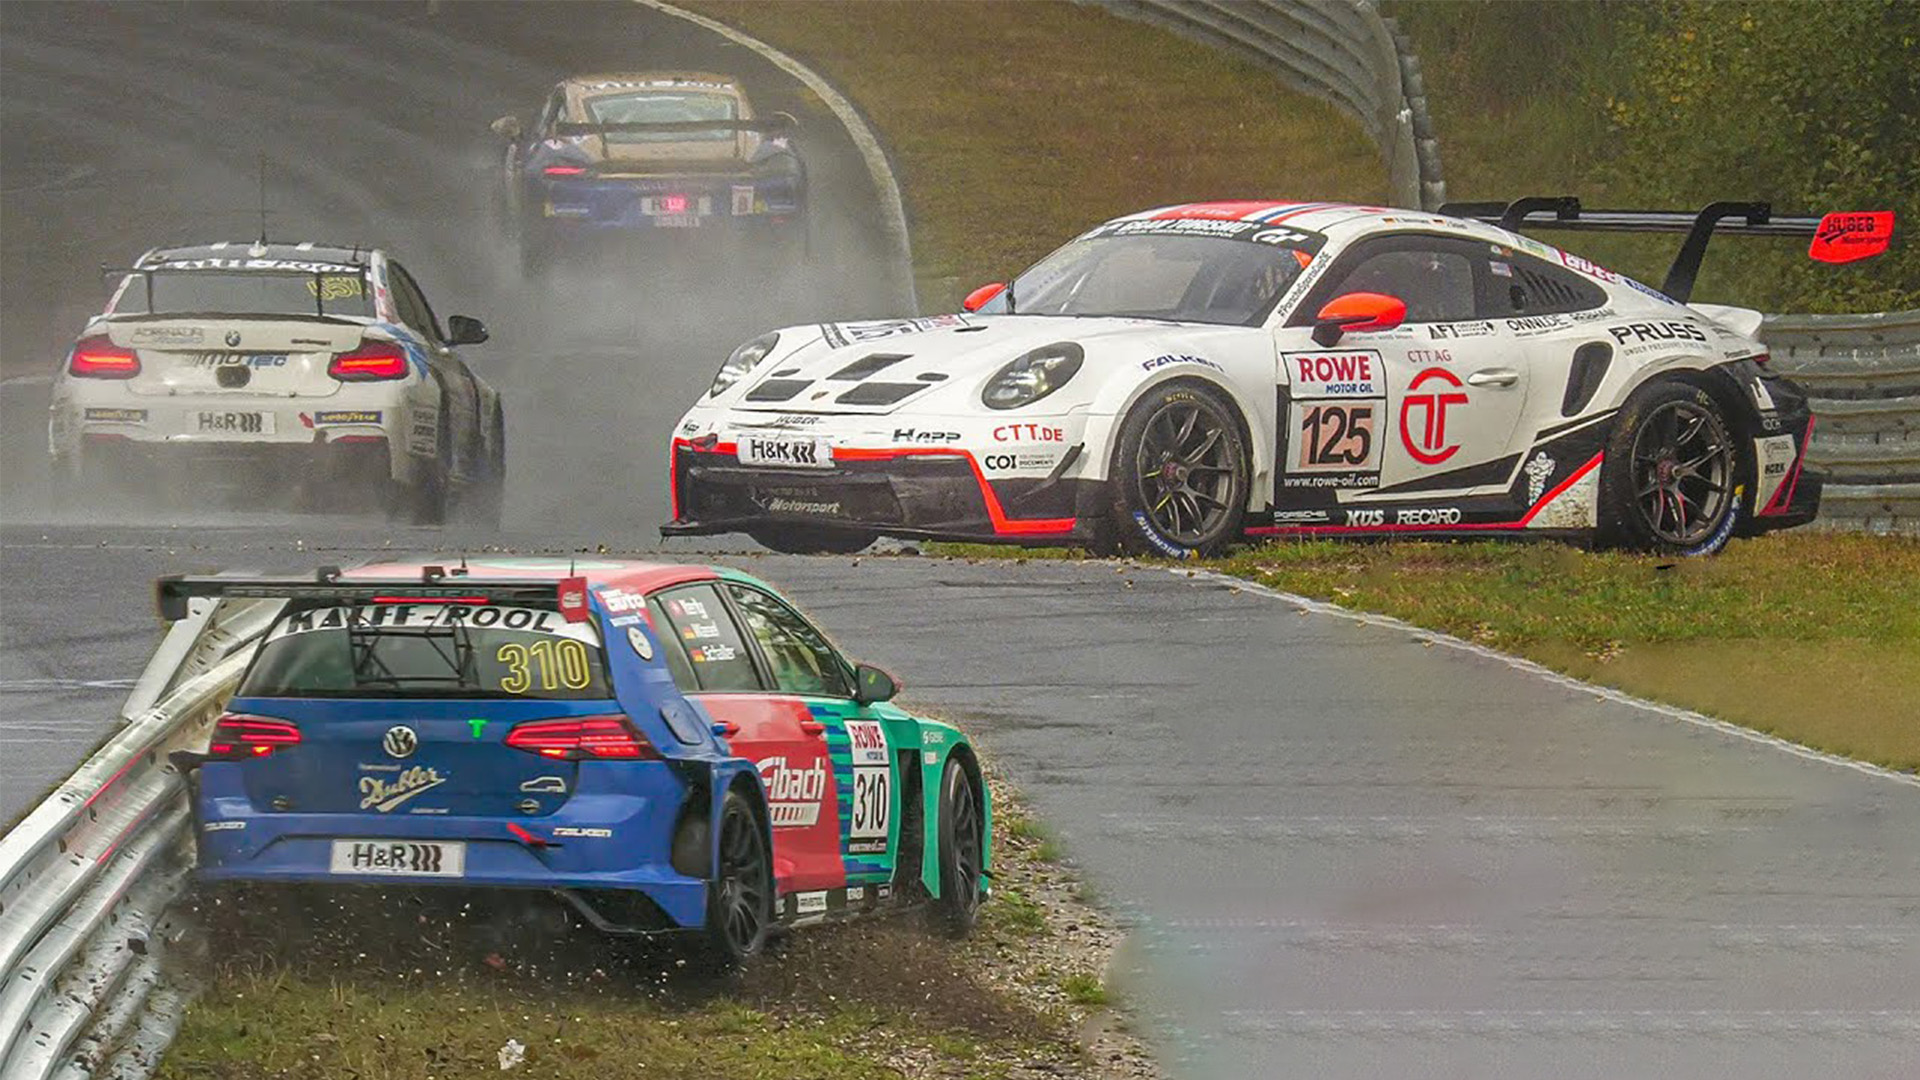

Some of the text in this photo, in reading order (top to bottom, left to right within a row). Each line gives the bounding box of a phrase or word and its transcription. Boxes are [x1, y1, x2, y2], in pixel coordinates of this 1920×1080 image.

[1608, 321, 1707, 345] PRUSS
[1141, 354, 1225, 372] FALKEN
[1407, 349, 1452, 363] CTT AG
[1296, 355, 1371, 382] ROWE
[1325, 383, 1373, 394] MOTOR OIL
[198, 411, 236, 431] H&R
[993, 423, 1064, 442] CTT.DE
[1302, 406, 1371, 465] 125
[985, 455, 1017, 470] COI
[1284, 472, 1379, 488] www.rowe-oil.com
[768, 499, 842, 514] Motorsport
[1396, 508, 1462, 526] RECARO
[497, 638, 591, 694] 310
[851, 724, 884, 749] ROWE
[756, 756, 827, 801] Eibach
[854, 773, 887, 831] 310
[352, 843, 406, 870] H&R
